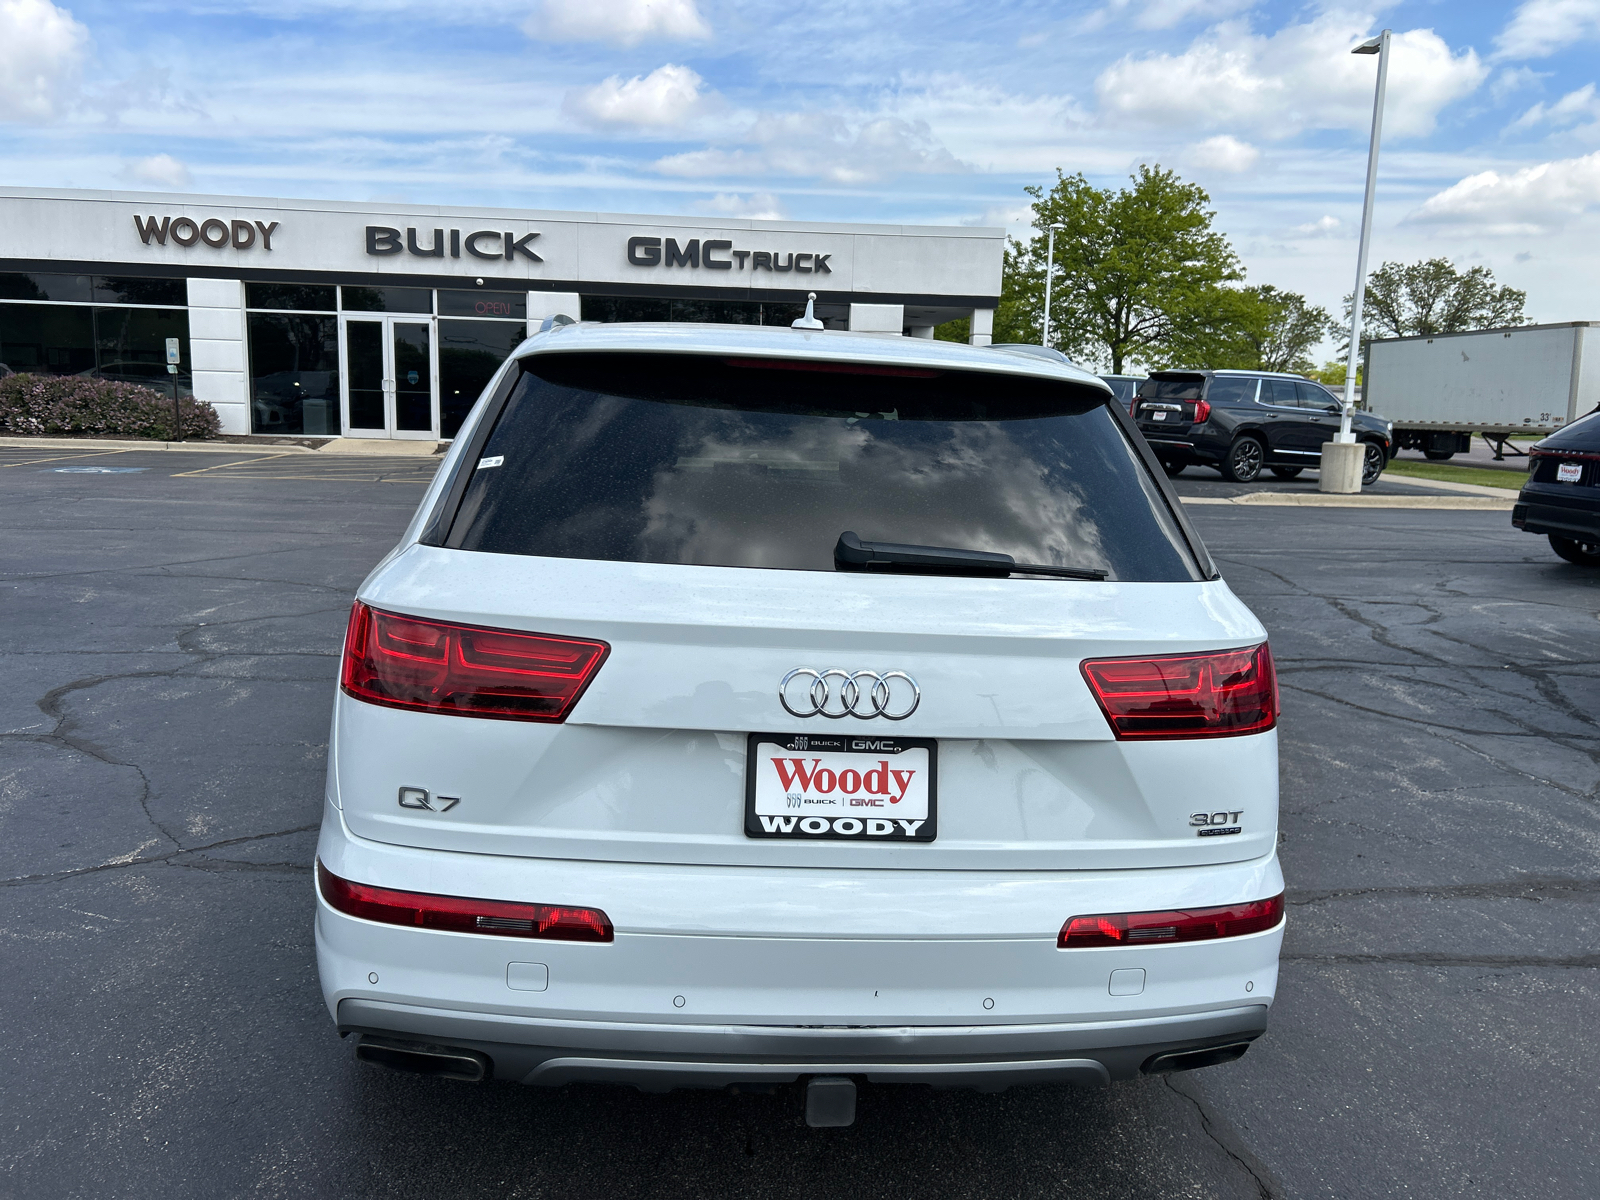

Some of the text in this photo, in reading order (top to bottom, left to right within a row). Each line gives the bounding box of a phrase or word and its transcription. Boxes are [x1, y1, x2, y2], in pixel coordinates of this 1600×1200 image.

[134, 215, 279, 250] WOODY
[366, 226, 544, 262] BUICK
[475, 301, 510, 315] OPEN
[852, 740, 894, 750] GMC
[770, 758, 916, 804] Woody
[398, 786, 461, 812] Q7
[850, 798, 884, 807] GMC
[759, 816, 926, 836] WOODY
